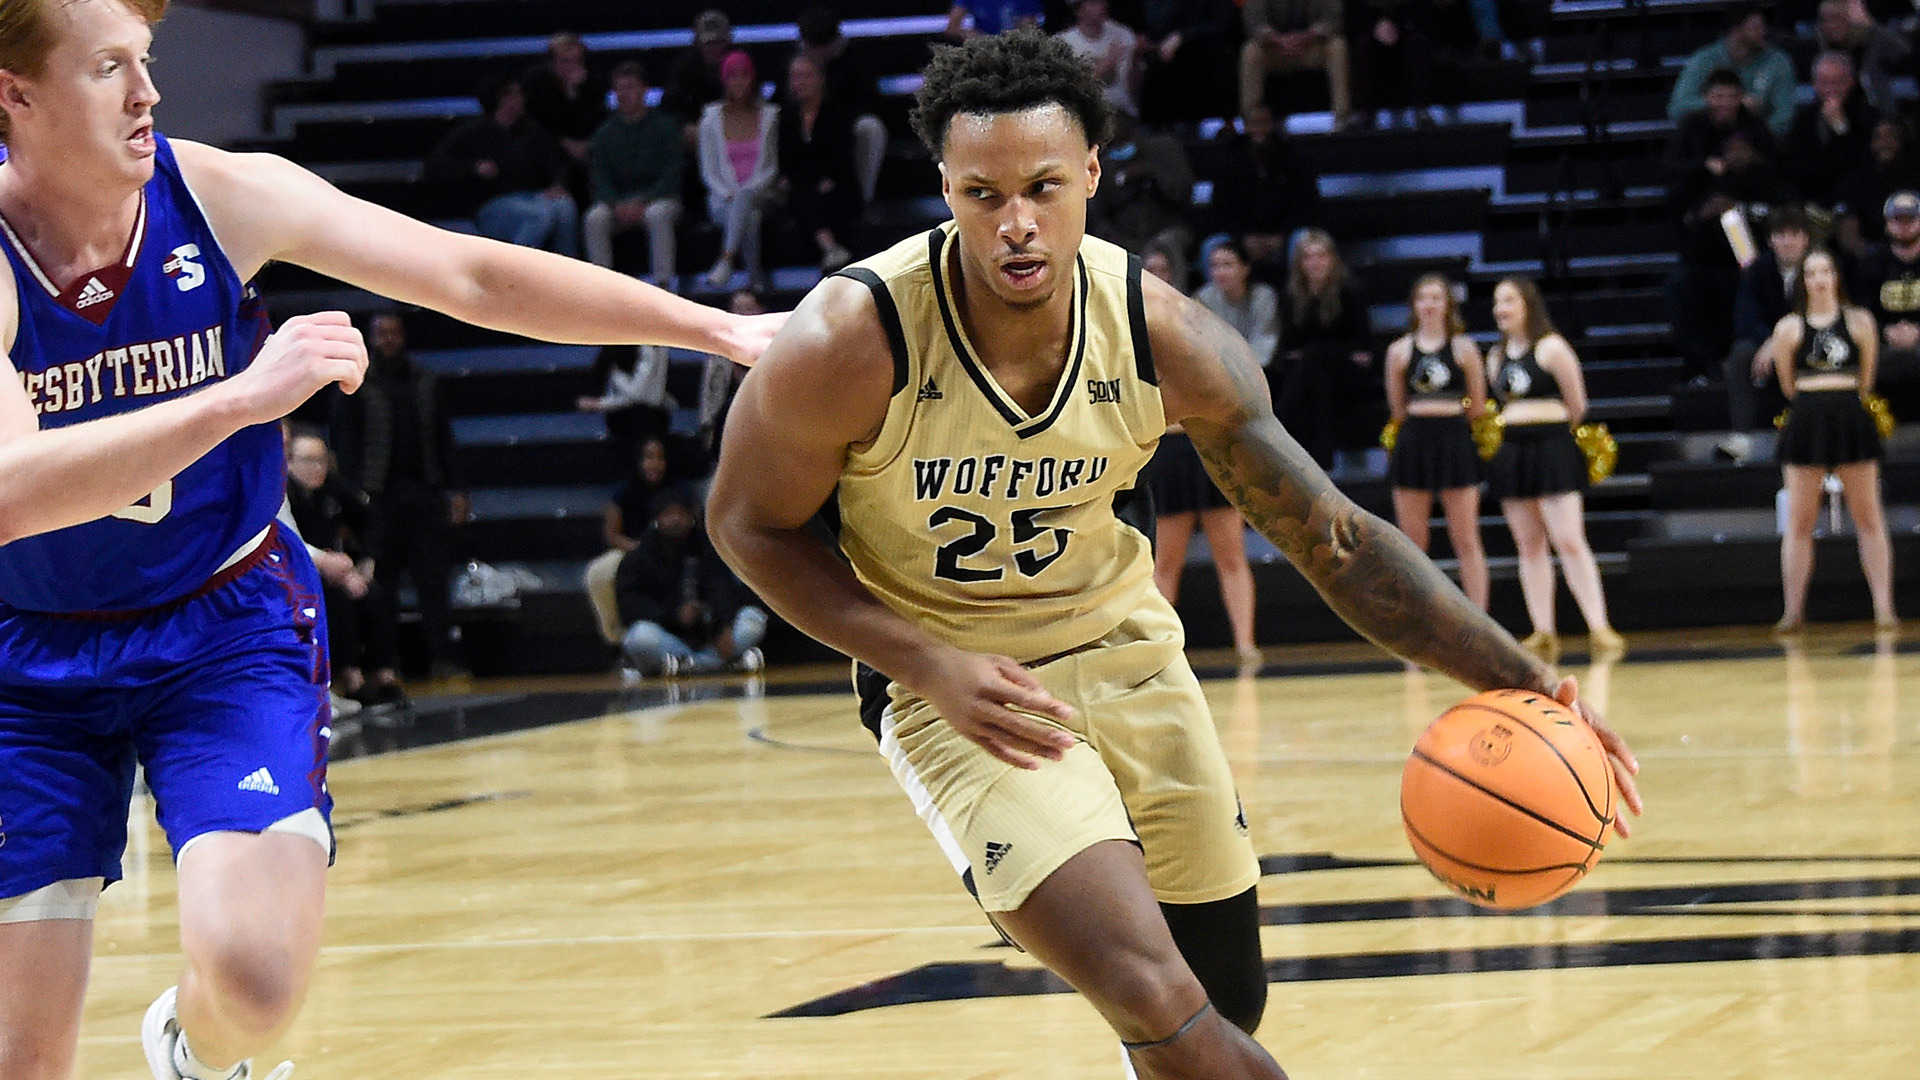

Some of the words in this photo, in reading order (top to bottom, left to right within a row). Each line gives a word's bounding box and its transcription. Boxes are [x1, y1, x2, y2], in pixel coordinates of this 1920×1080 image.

[75, 290, 115, 309] adidas
[17, 325, 226, 415] ESBYTERIAN
[928, 504, 1076, 583] 25
